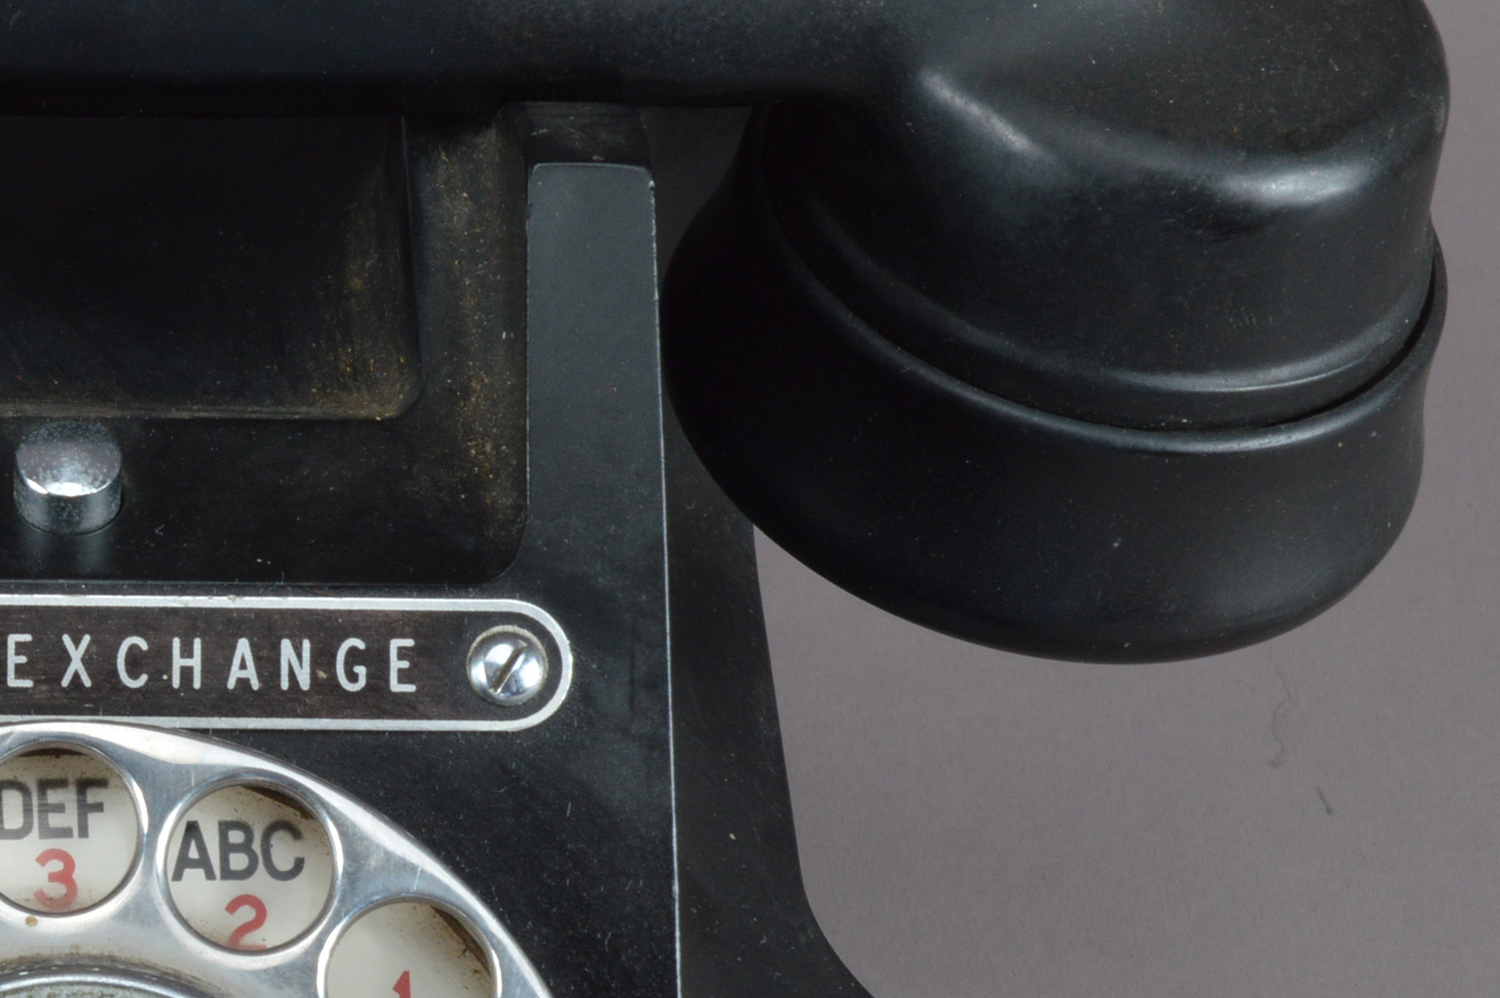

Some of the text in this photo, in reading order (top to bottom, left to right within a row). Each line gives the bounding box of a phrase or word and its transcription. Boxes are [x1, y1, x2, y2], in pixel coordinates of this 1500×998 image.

[6, 632, 416, 693] EXCHANGE
[34, 848, 78, 909] 3
[171, 820, 306, 883] ABC
[225, 894, 269, 951] 2
